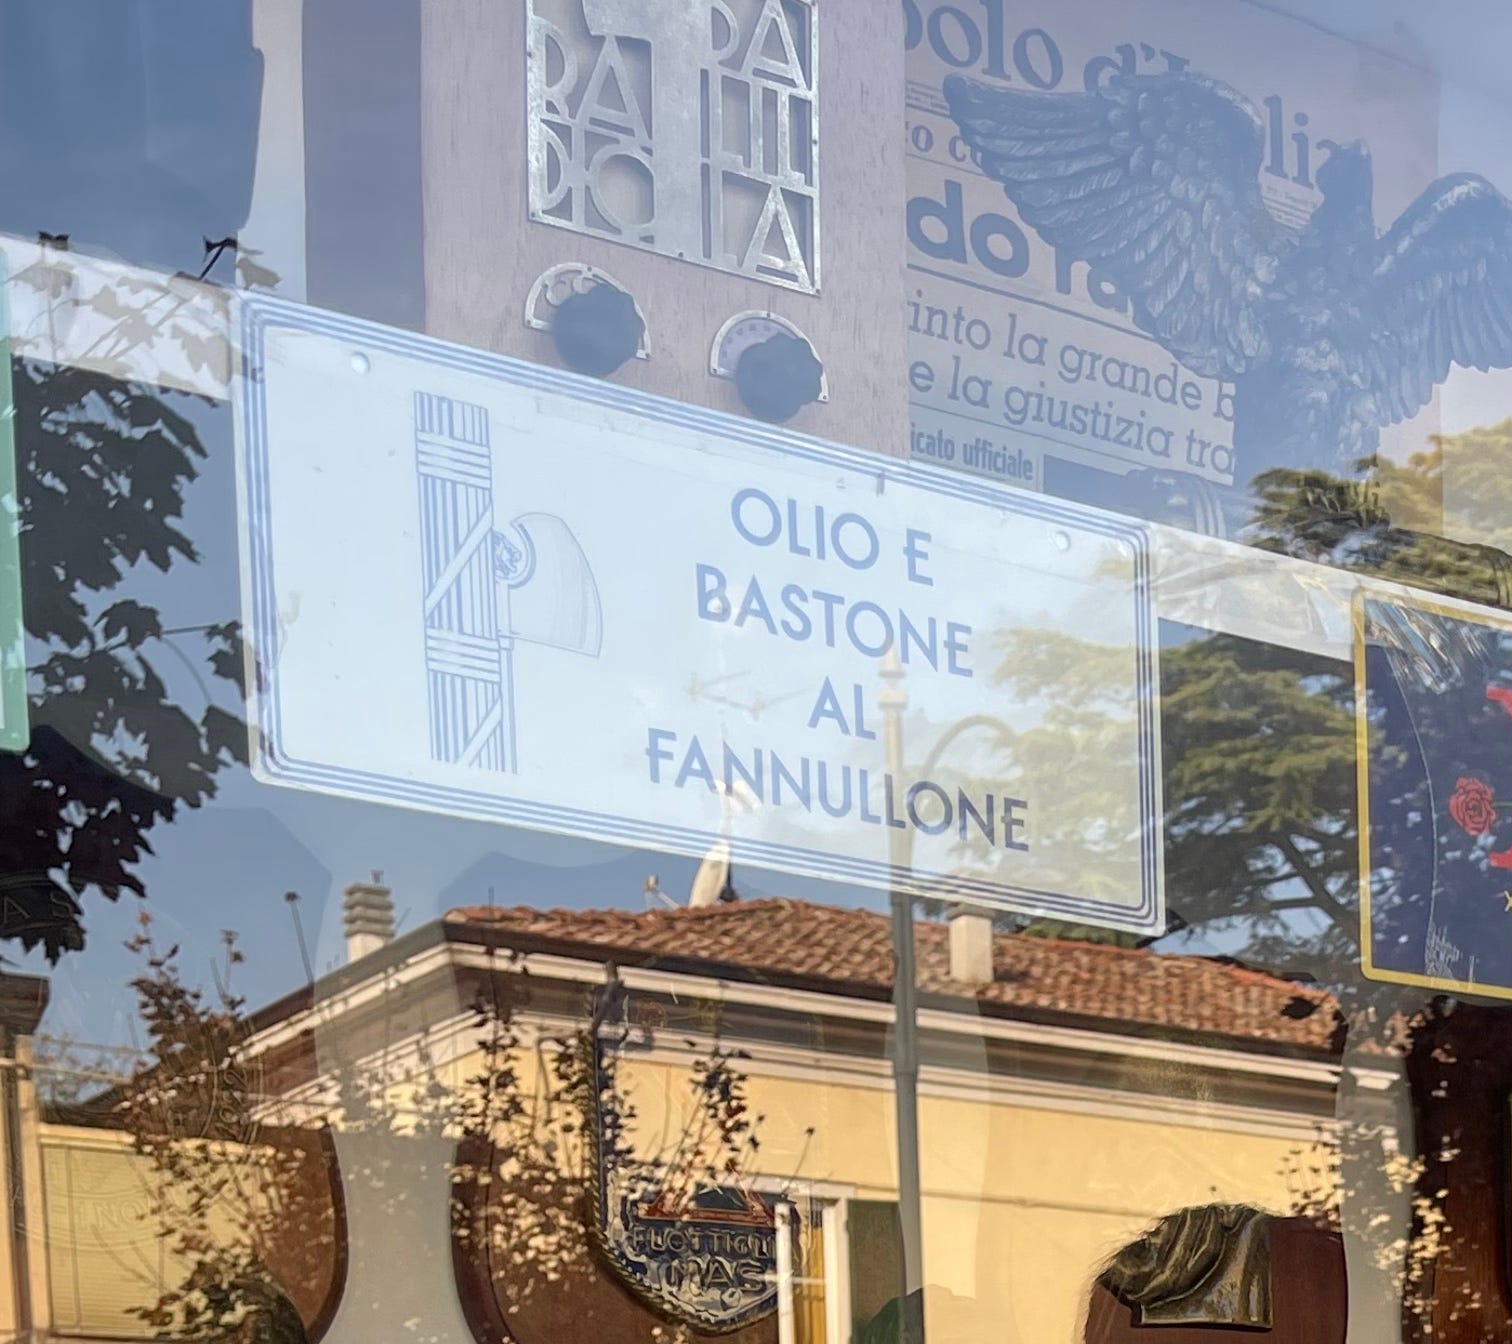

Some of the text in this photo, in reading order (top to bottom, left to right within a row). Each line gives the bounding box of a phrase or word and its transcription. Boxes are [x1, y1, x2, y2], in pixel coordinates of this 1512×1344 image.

[908, 360, 935, 393] e
[947, 355, 993, 408] la
[1003, 381, 1175, 458] giustizia
[1003, 313, 1048, 366] la
[1058, 343, 1203, 412] grande
[963, 437, 1034, 481] ufficiale
[731, 488, 934, 586] OLIO E
[696, 562, 974, 678] BASTONE
[808, 676, 877, 741] AL
[645, 727, 1030, 853] FANNULLONE
[632, 1226, 778, 1259] FLOTTIGLI
